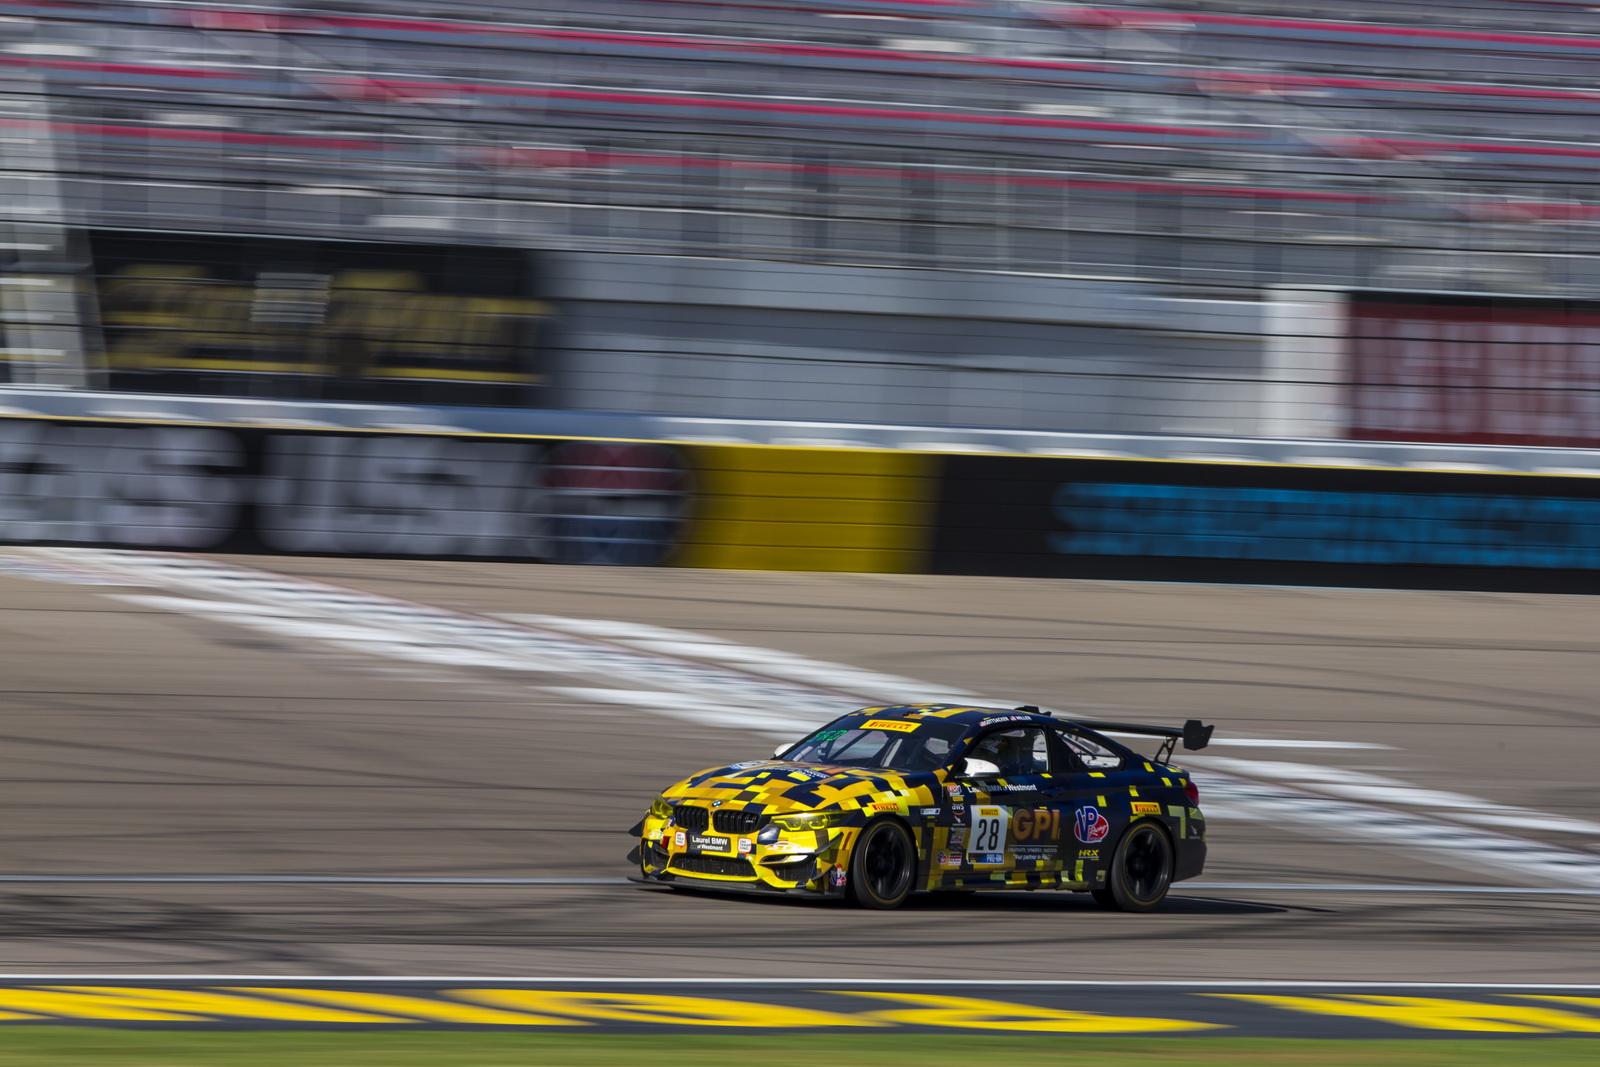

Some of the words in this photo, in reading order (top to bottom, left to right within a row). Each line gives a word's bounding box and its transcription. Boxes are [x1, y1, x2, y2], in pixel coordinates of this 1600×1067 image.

[868, 721, 912, 730] PIRELLI
[1007, 783, 1037, 792] Westmont
[872, 803, 899, 811] PIRELLI
[1134, 804, 1159, 813] PIRELLI
[1012, 808, 1060, 841] GPI
[975, 819, 999, 851] 28
[691, 835, 710, 844] Laurel
[711, 837, 728, 846] BMW
[1078, 849, 1099, 857] HRX
